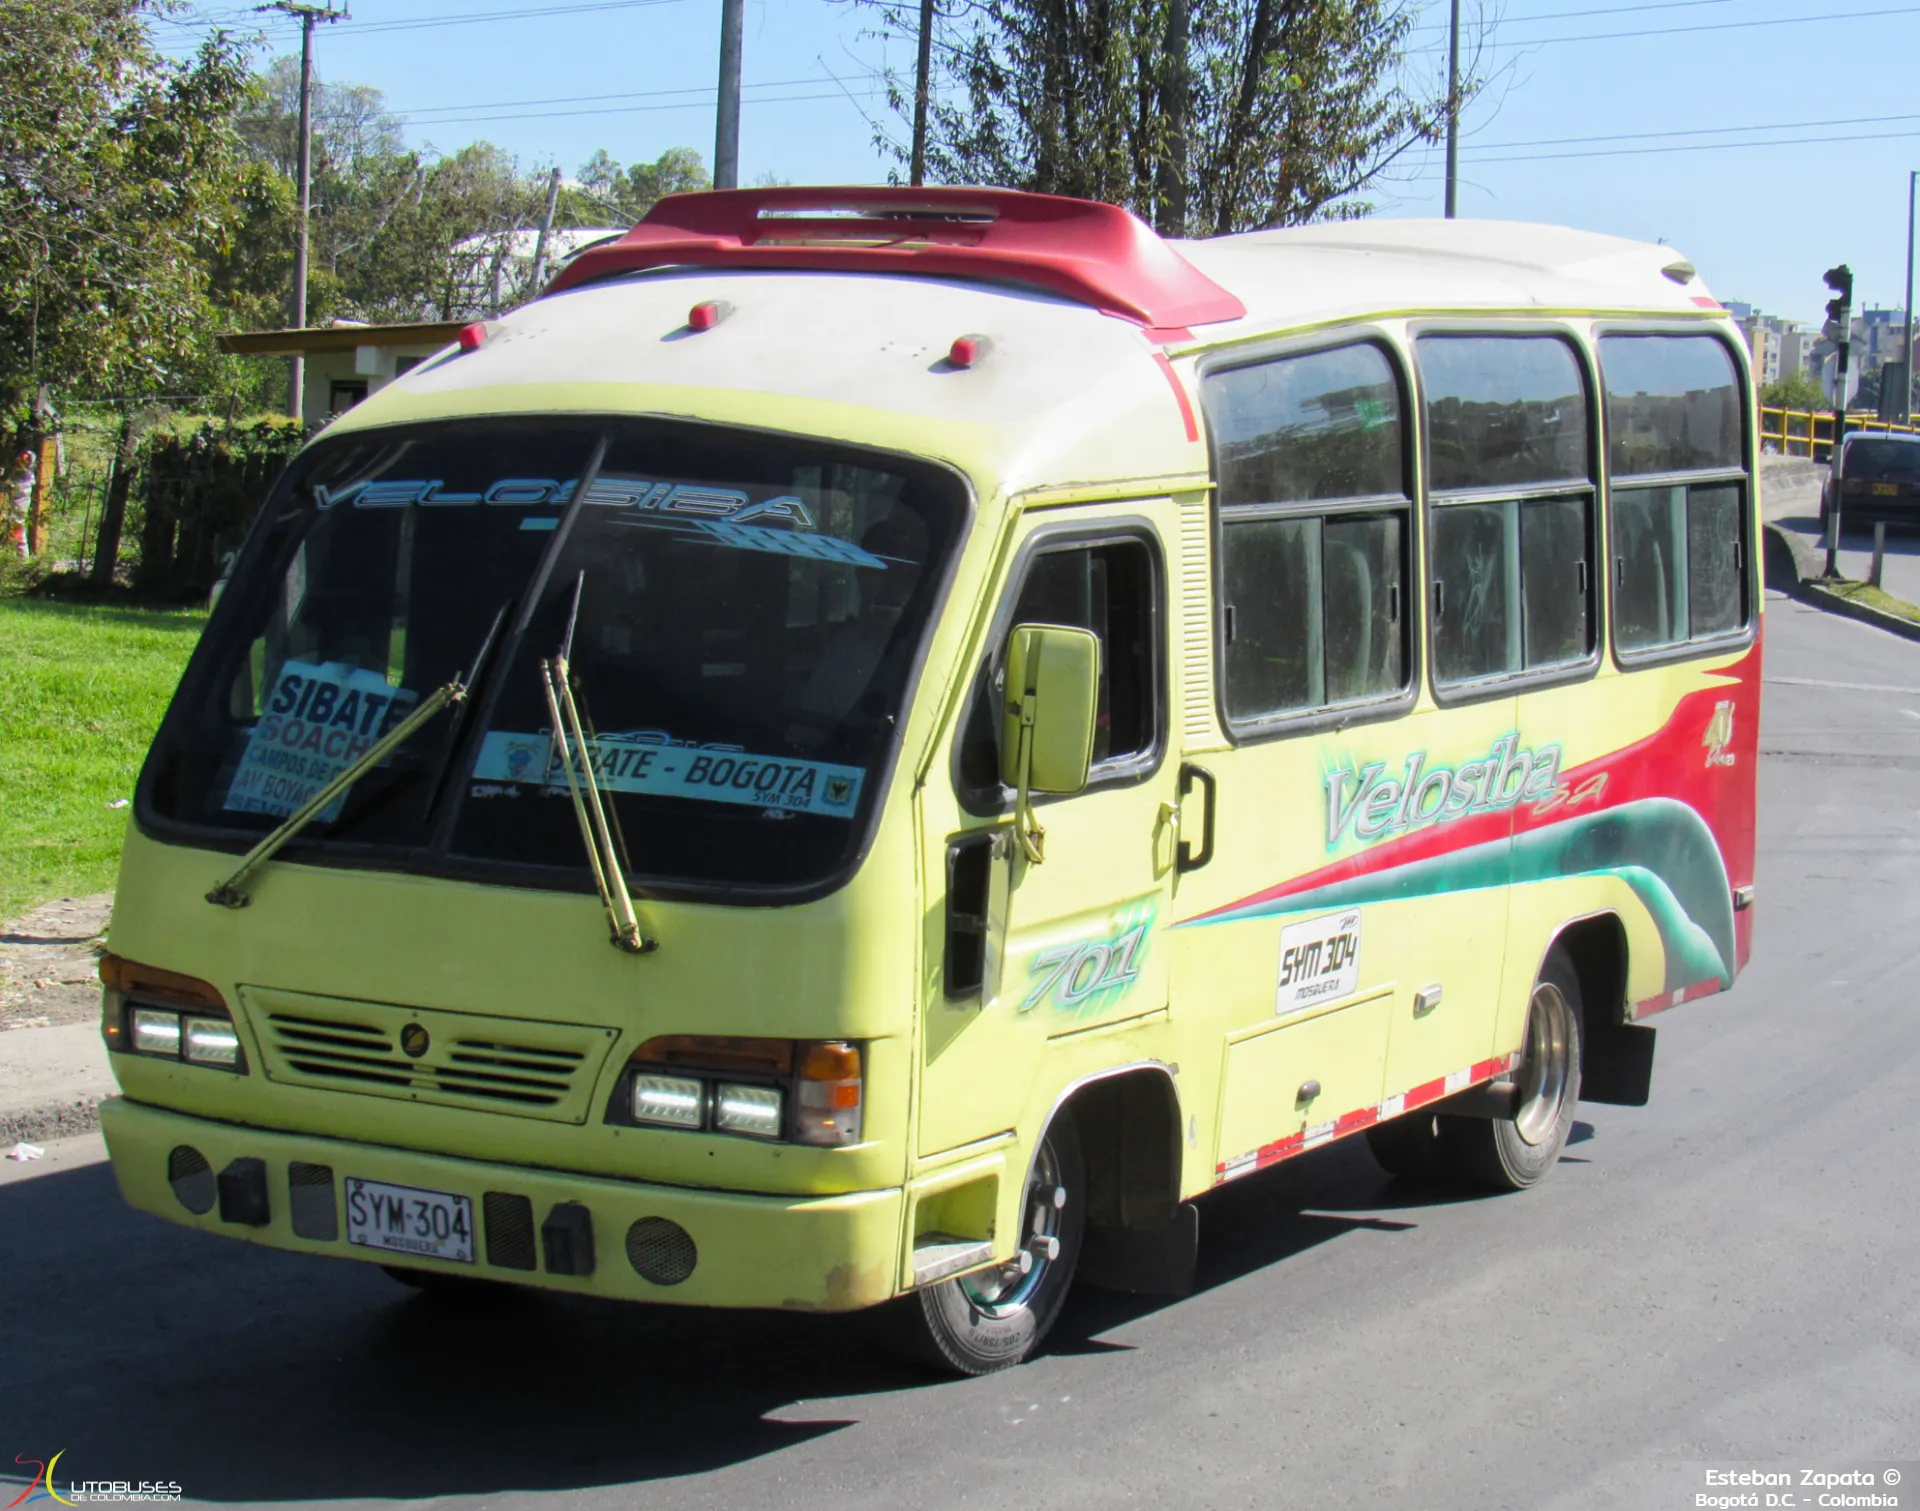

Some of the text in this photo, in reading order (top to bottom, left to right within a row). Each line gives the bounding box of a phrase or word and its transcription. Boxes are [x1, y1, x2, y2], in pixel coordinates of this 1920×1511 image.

[261, 714, 378, 761] SOACH
[262, 774, 319, 805] BOYAC
[306, 760, 330, 781] DE
[685, 756, 817, 795] BOGOTA
[1326, 734, 1560, 844] Velosiba
[752, 791, 812, 808] SYM 304
[1019, 924, 1146, 1012] 701
[1279, 932, 1358, 987] SYM 304
[1295, 978, 1340, 1001] MOSQUERA
